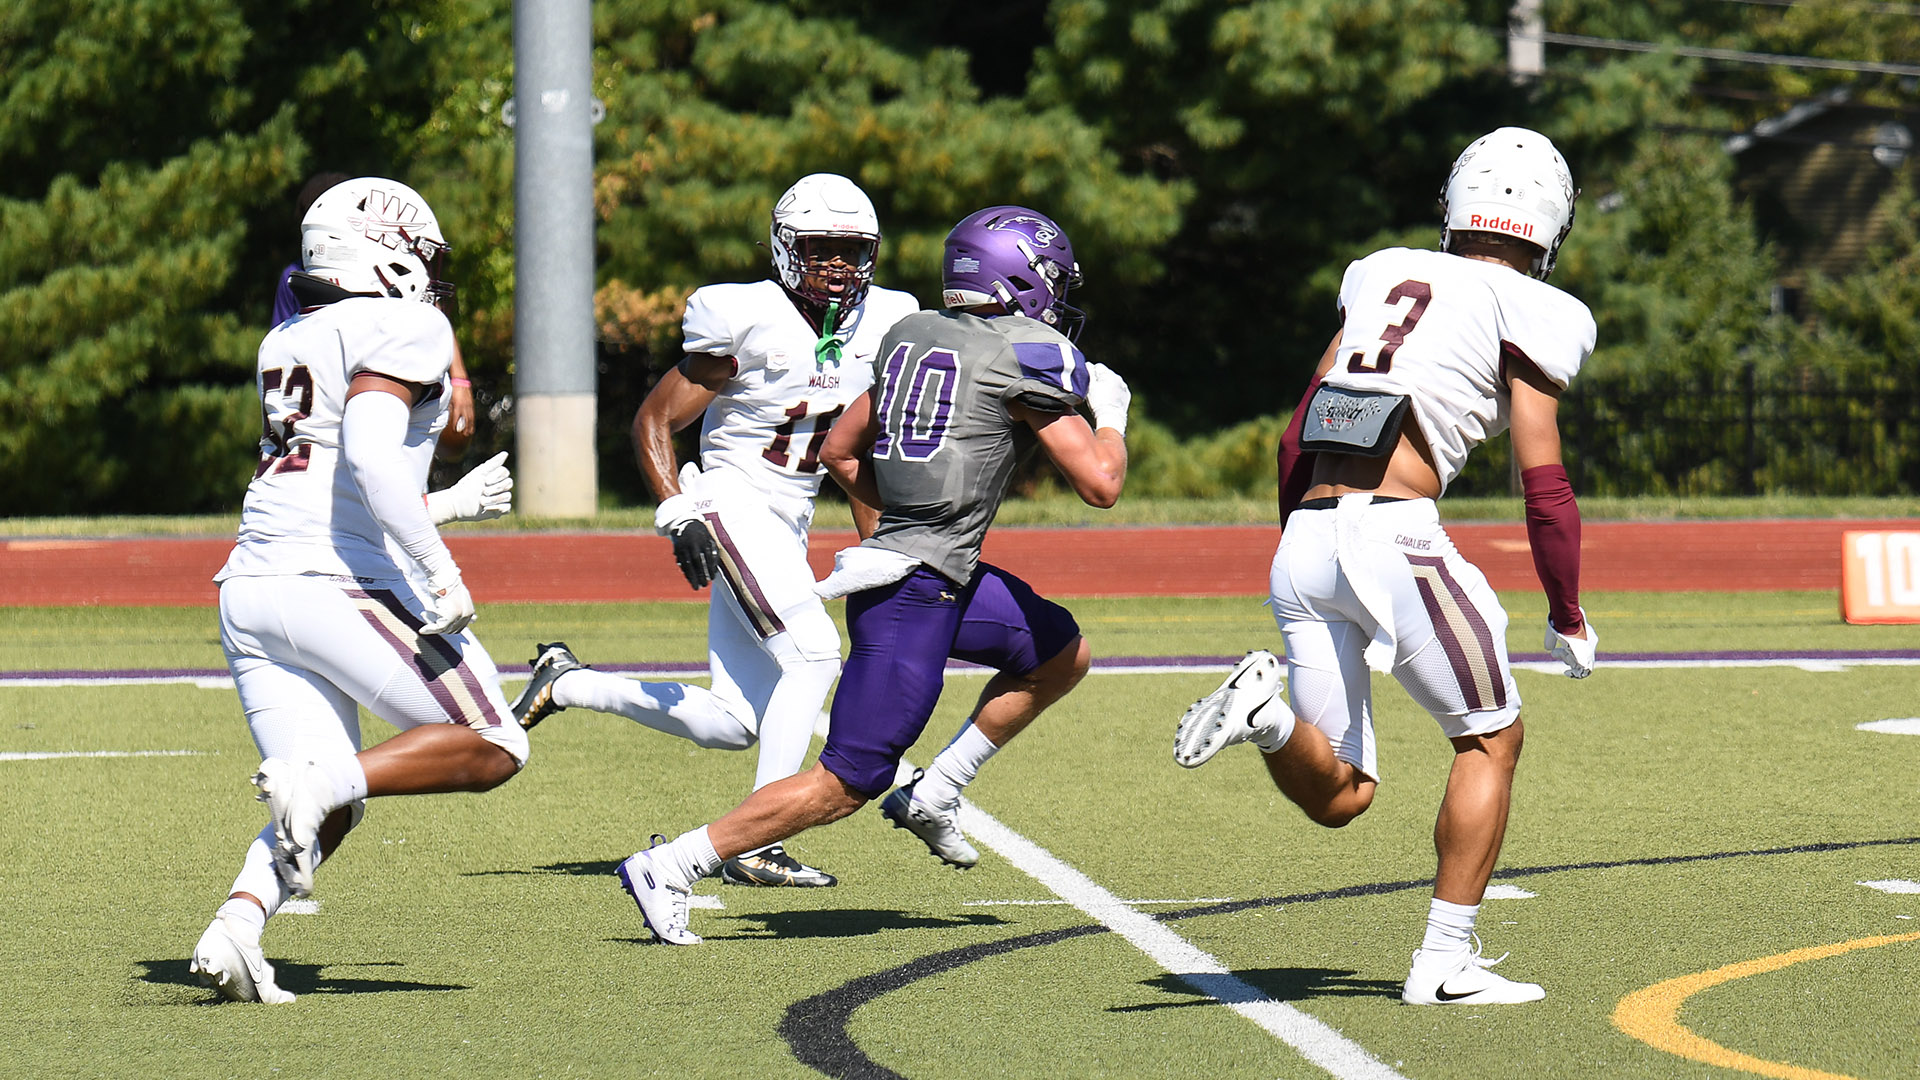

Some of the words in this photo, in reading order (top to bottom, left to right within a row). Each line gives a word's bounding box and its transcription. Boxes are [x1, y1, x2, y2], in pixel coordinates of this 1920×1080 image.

[1470, 213, 1534, 238] Riddell
[945, 292, 966, 304] dell
[1346, 278, 1433, 375] 3
[808, 375, 841, 389] WALSH
[872, 341, 962, 463] 10
[251, 364, 315, 480] 52
[762, 401, 847, 475] 11
[1394, 533, 1432, 551] CAVALIERS
[1855, 531, 1920, 607] 10
